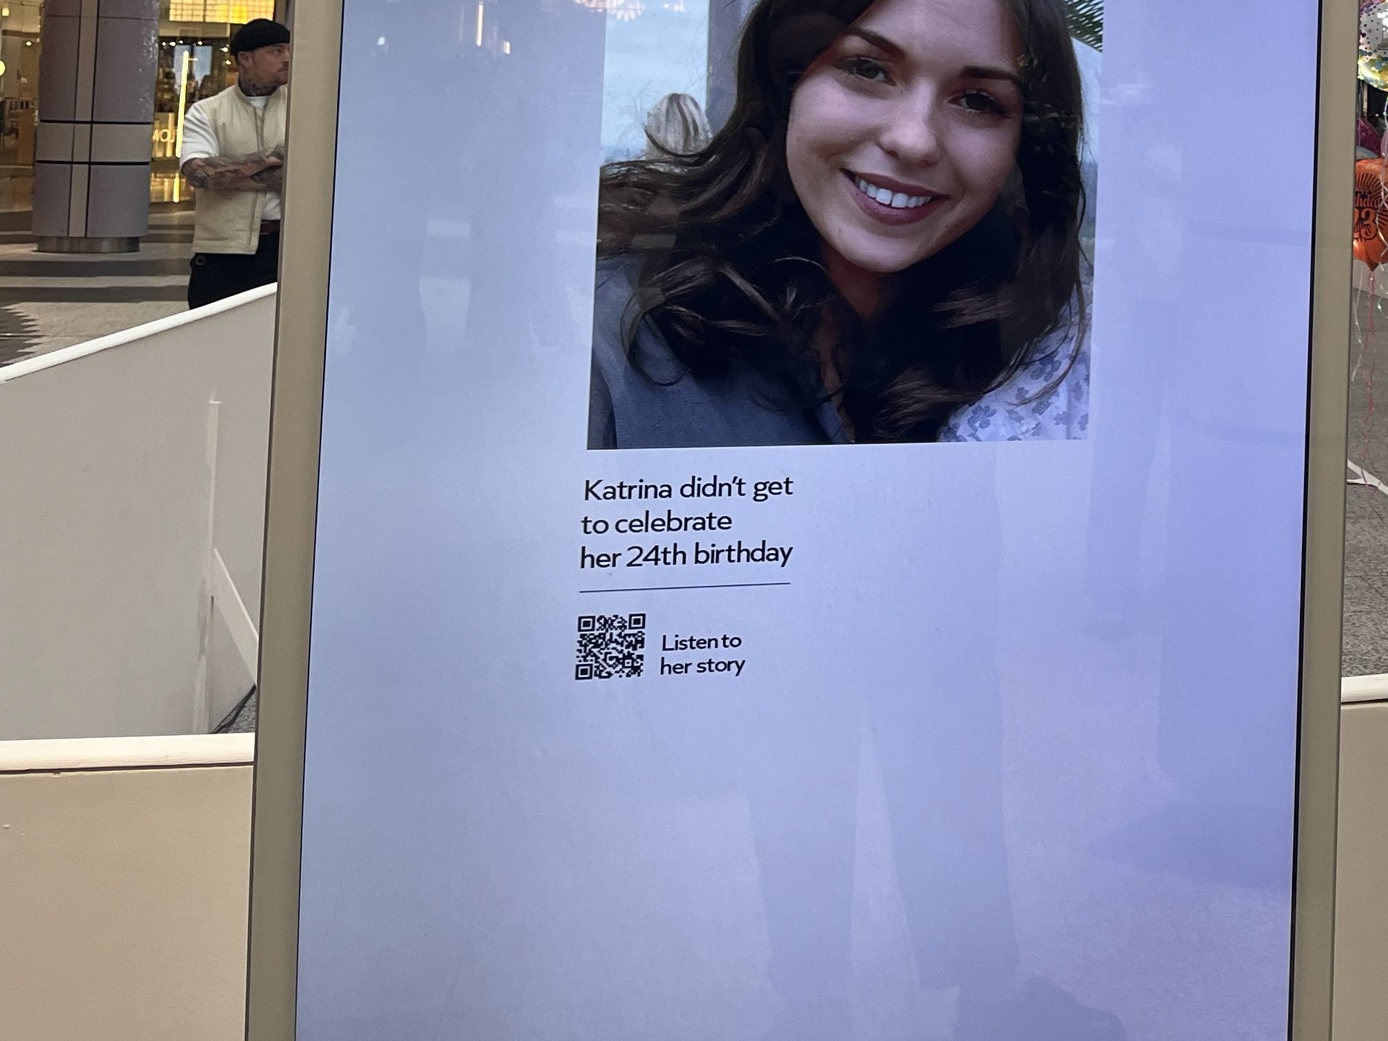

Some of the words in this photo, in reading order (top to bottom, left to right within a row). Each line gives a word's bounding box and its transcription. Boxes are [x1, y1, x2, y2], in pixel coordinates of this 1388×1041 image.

[584, 478, 673, 501] Katrina
[679, 475, 746, 499] didn't
[753, 476, 794, 502] get
[581, 515, 609, 535] to
[615, 509, 733, 534] celebrate
[580, 546, 622, 569] her
[626, 542, 687, 568] 24th
[694, 540, 794, 568] birthday
[662, 634, 719, 651] Listen
[721, 635, 742, 649] to
[660, 656, 692, 675] her
[696, 658, 746, 676] story
